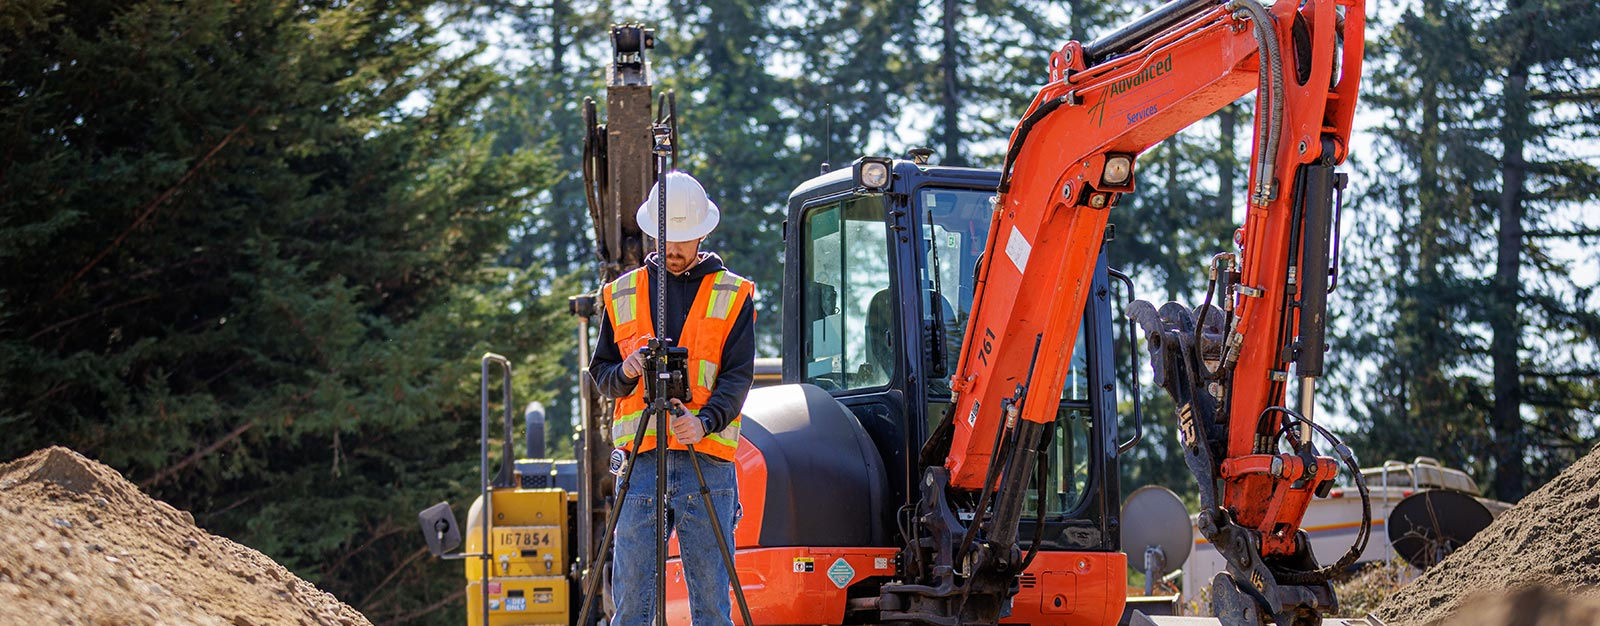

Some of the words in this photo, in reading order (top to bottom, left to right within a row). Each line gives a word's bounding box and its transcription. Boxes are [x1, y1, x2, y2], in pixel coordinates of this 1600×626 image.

[1110, 53, 1172, 97] Advanced
[1126, 104, 1158, 125] Services
[978, 327, 996, 366] 761
[500, 532, 549, 546] 167854
